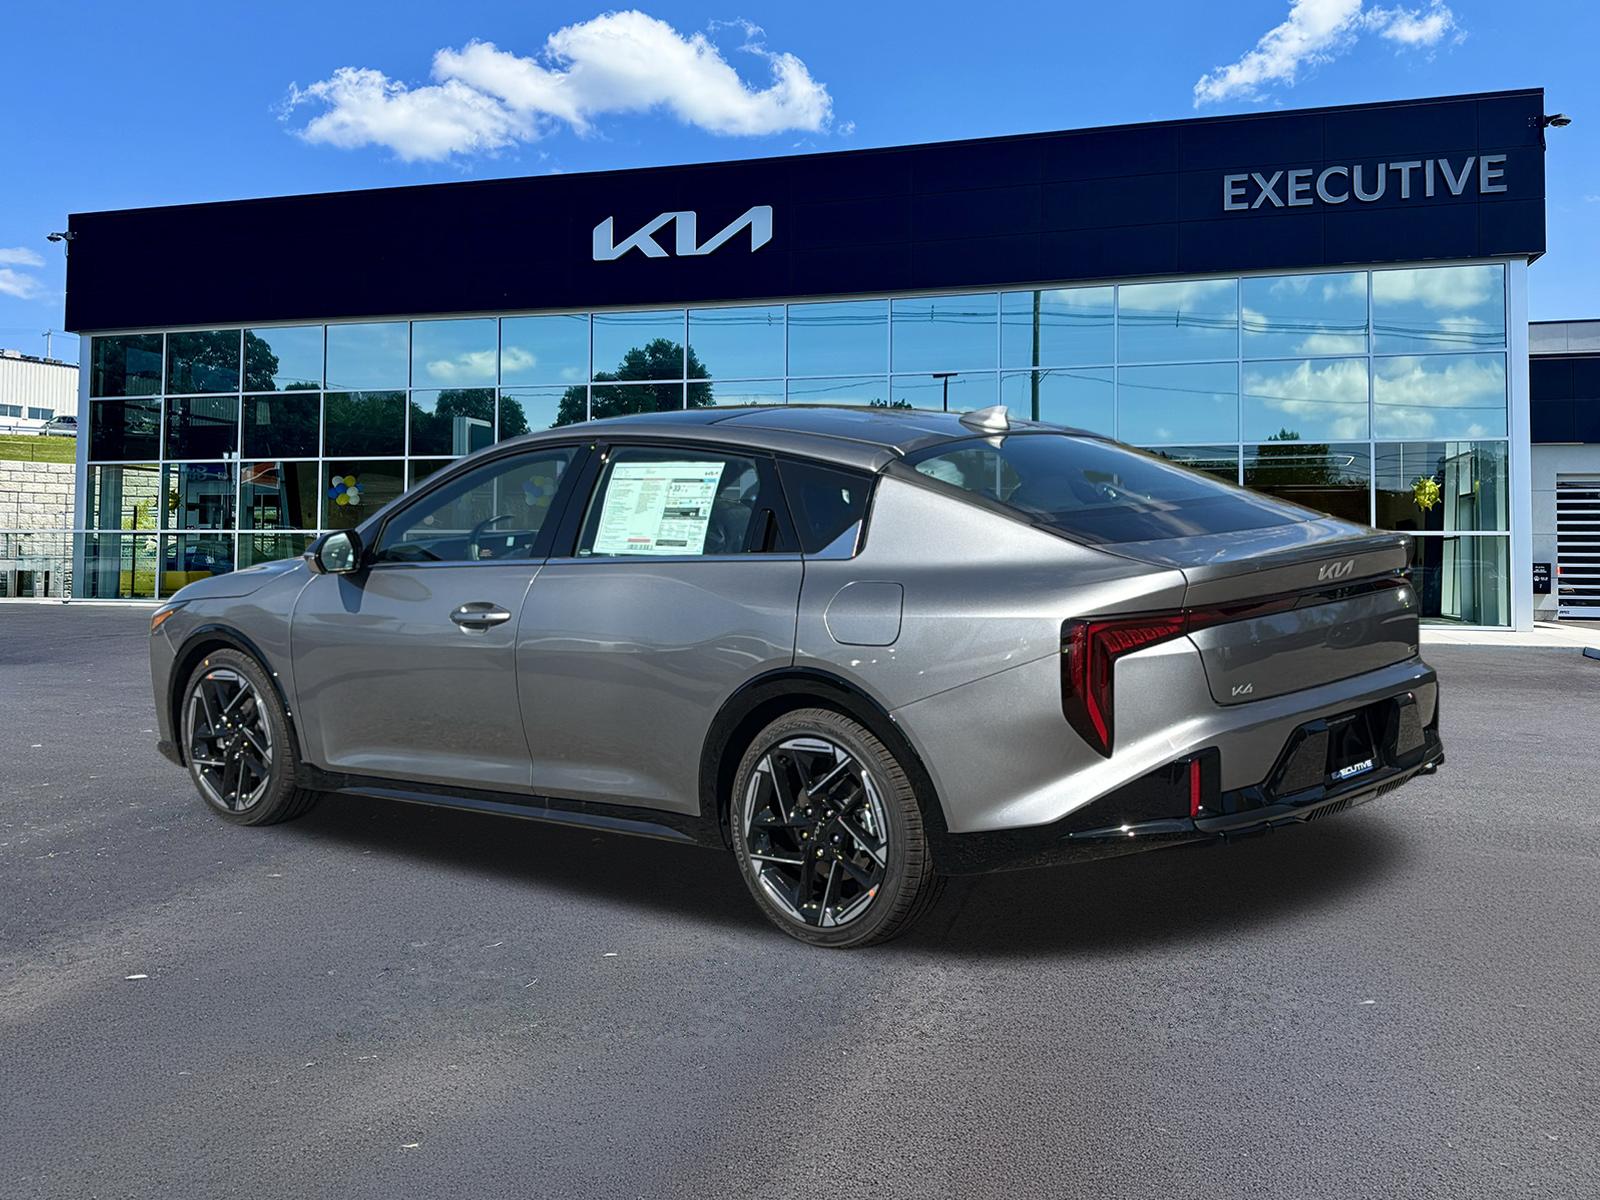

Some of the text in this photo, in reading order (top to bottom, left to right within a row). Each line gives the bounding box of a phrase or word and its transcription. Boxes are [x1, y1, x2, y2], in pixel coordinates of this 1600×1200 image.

[1223, 154, 1508, 212] EXECUTIVE
[593, 205, 773, 262] KIA
[1318, 559, 1355, 581] KIA
[1231, 682, 1254, 697] K4
[732, 814, 748, 872] KUMHO
